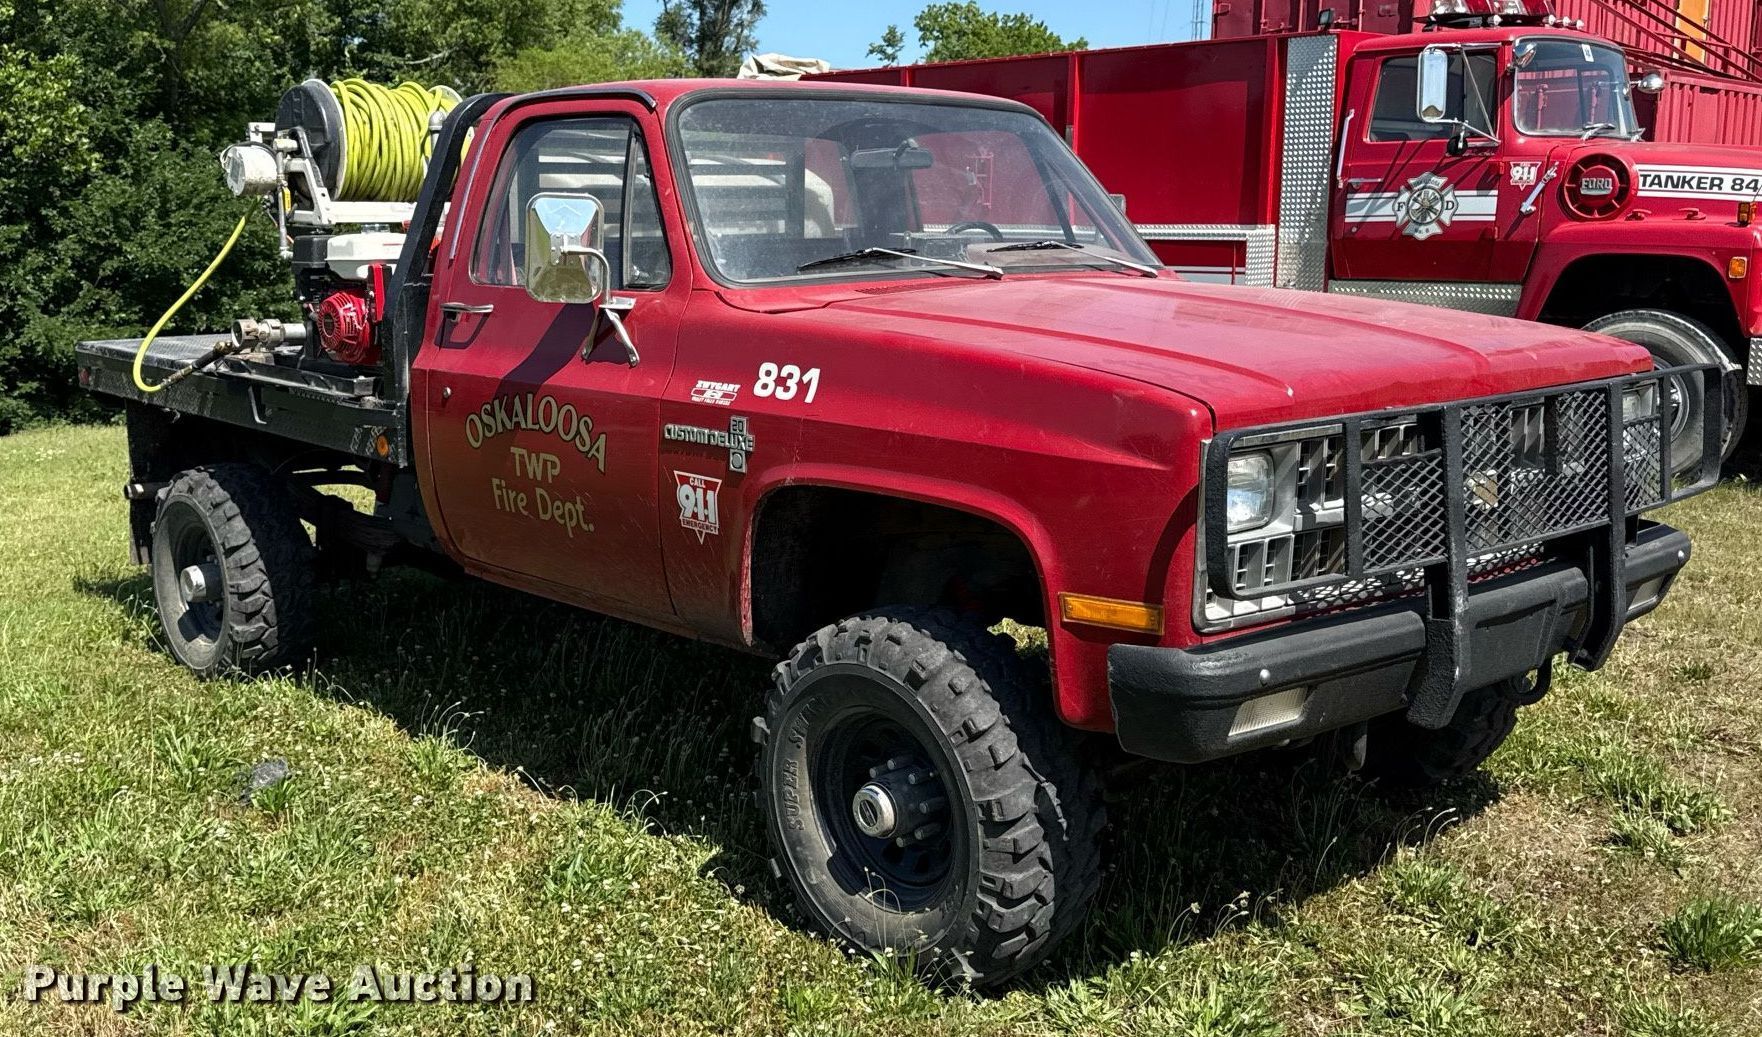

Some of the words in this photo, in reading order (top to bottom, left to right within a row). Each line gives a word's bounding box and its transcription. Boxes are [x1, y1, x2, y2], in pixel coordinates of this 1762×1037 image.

[1581, 177, 1613, 191] FORD
[1639, 173, 1724, 191] TANKER
[1730, 177, 1761, 193] 84
[1396, 201, 1406, 212] F
[1445, 200, 1455, 211] D
[753, 362, 821, 404] 831
[465, 392, 608, 474] OSKALOOSA
[663, 423, 709, 445] CUSTOM
[709, 430, 756, 452] DELUXE
[510, 446, 561, 484] TWP
[689, 476, 706, 489] CALL
[491, 477, 529, 517] Fire
[535, 491, 595, 539] Dept.
[682, 518, 718, 534] EMERGENCY
[782, 758, 805, 831] SUPER
